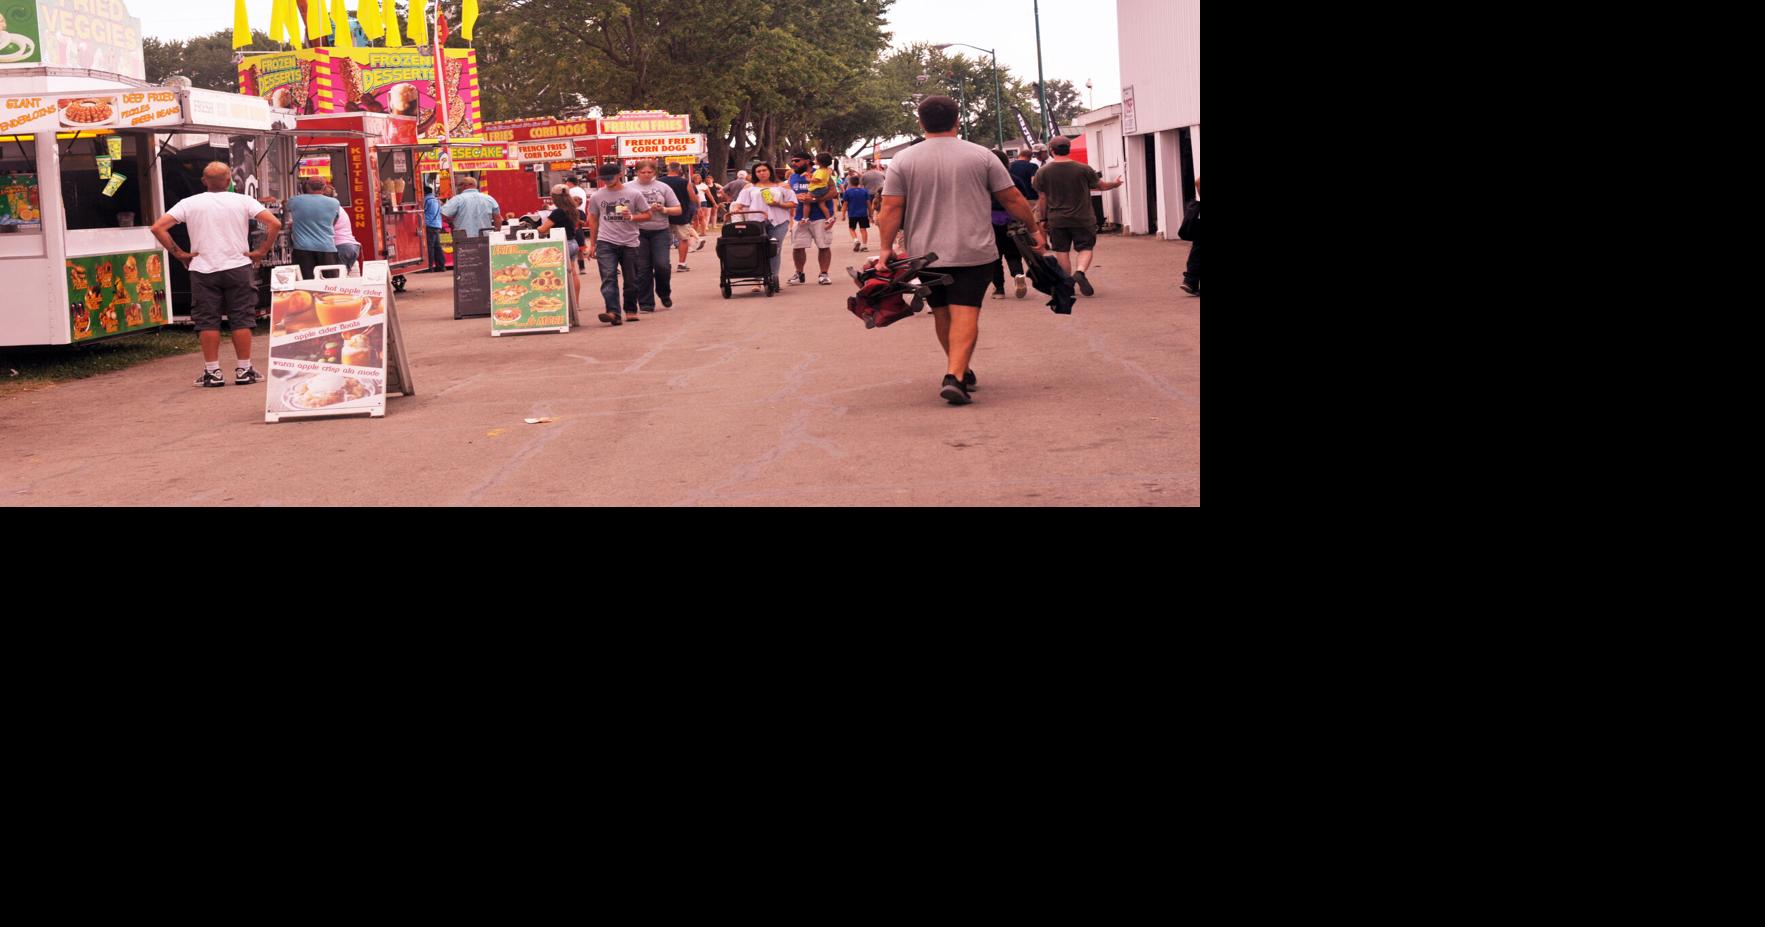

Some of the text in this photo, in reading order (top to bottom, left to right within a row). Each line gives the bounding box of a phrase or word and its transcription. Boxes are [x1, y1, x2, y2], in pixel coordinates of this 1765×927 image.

[41, 4, 137, 50] VEGGIES
[261, 55, 297, 72] FROZEN
[370, 53, 433, 68] FROZEN
[258, 69, 302, 97] DESSERTS
[6, 97, 42, 109] GIANT
[123, 91, 175, 104] DEEP FRIED
[0, 104, 56, 132] ENDERLOINS
[121, 104, 150, 118] PICKLES
[131, 106, 180, 126] GREEN BEANS
[489, 130, 514, 142] FRIES
[529, 125, 558, 139] CORN
[559, 123, 588, 136] DOGS
[603, 119, 683, 133] FRENCH FRIES
[518, 143, 567, 153] FRENCH FRIES
[625, 137, 696, 147] FRENCH FRIES
[631, 144, 687, 153] CORN DOGS
[427, 146, 503, 159] CESECAKE
[524, 150, 562, 159] CORN DOGS
[350, 146, 366, 228] KETTLE CORN
[339, 287, 361, 295] apple
[294, 329, 317, 341] apple
[318, 325, 338, 335] cider
[297, 362, 320, 371] apple
[321, 365, 341, 374] crisp
[357, 369, 380, 377] mode
